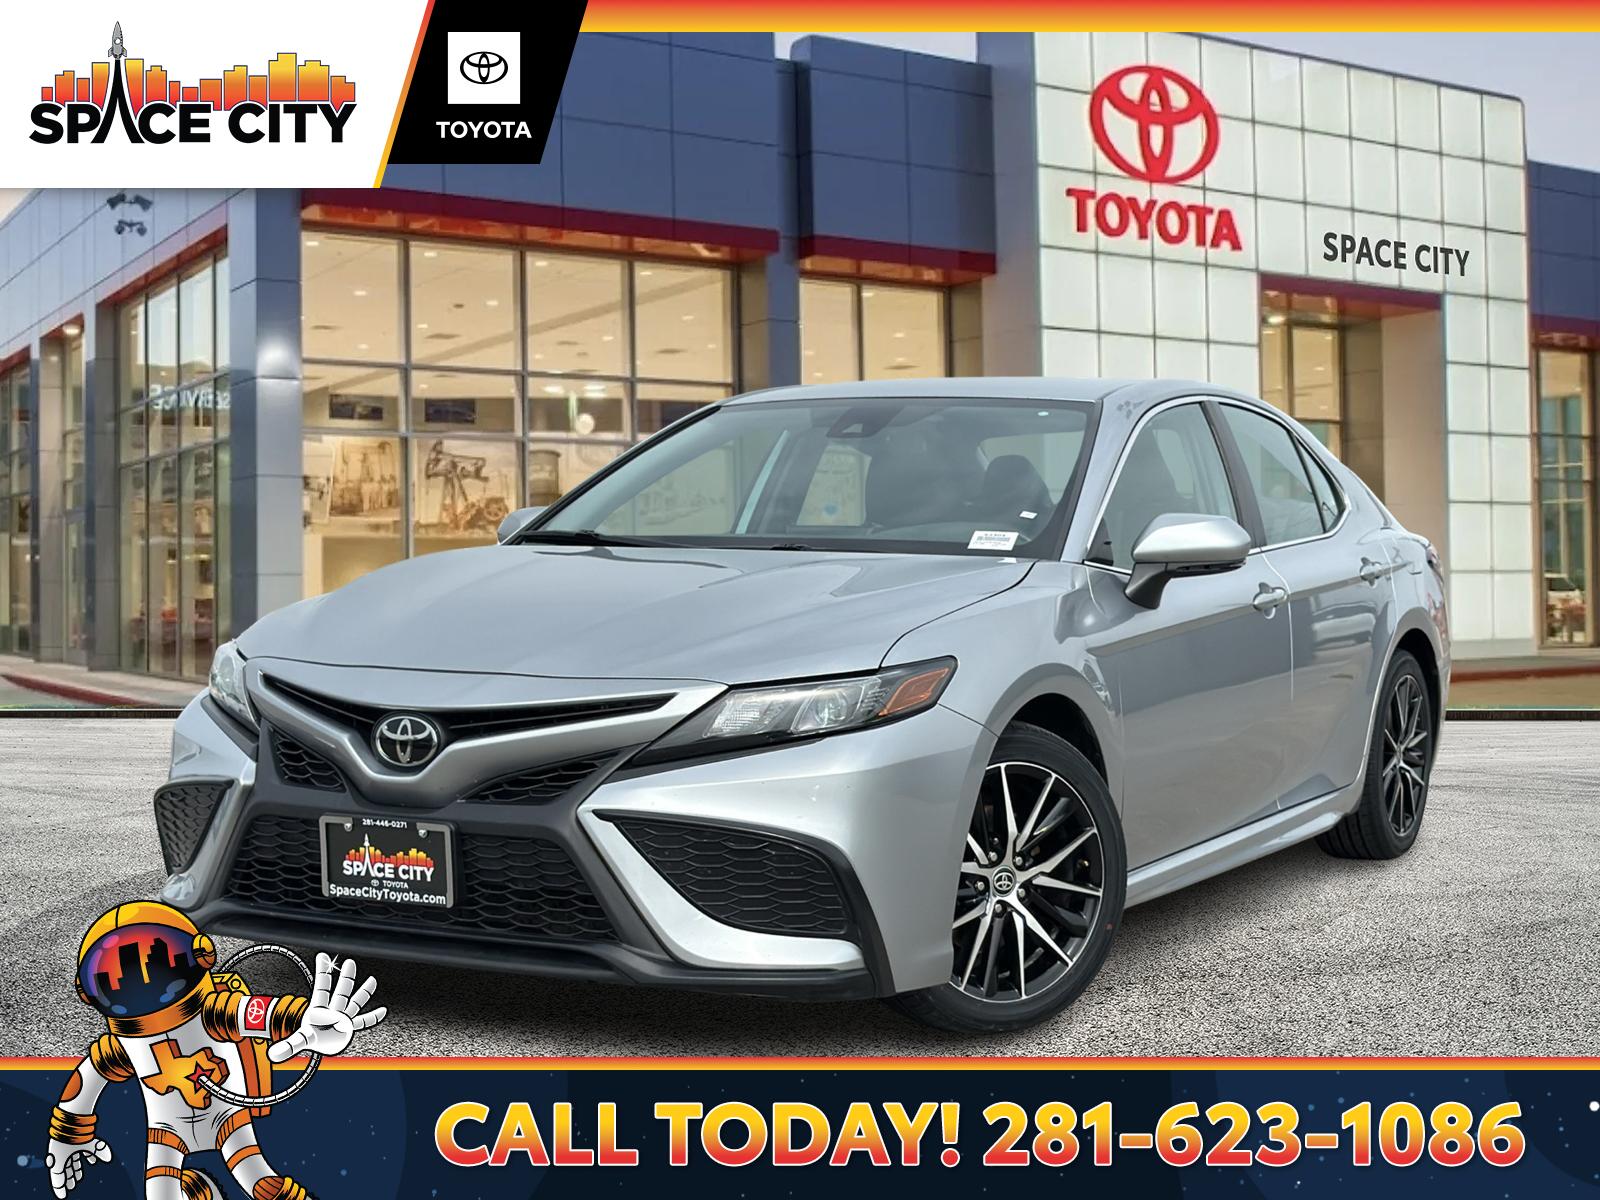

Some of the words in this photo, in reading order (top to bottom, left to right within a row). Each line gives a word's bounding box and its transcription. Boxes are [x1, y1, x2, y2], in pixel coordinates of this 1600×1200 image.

[1066, 187, 1242, 251] TOYOTA
[1323, 232, 1407, 269] SPACE
[1415, 244, 1470, 276] CITY
[342, 860, 394, 878] SPACE
[398, 865, 433, 881] CITY
[330, 884, 446, 904] SpaceCityToyota.com
[382, 880, 409, 889] TOYOTA
